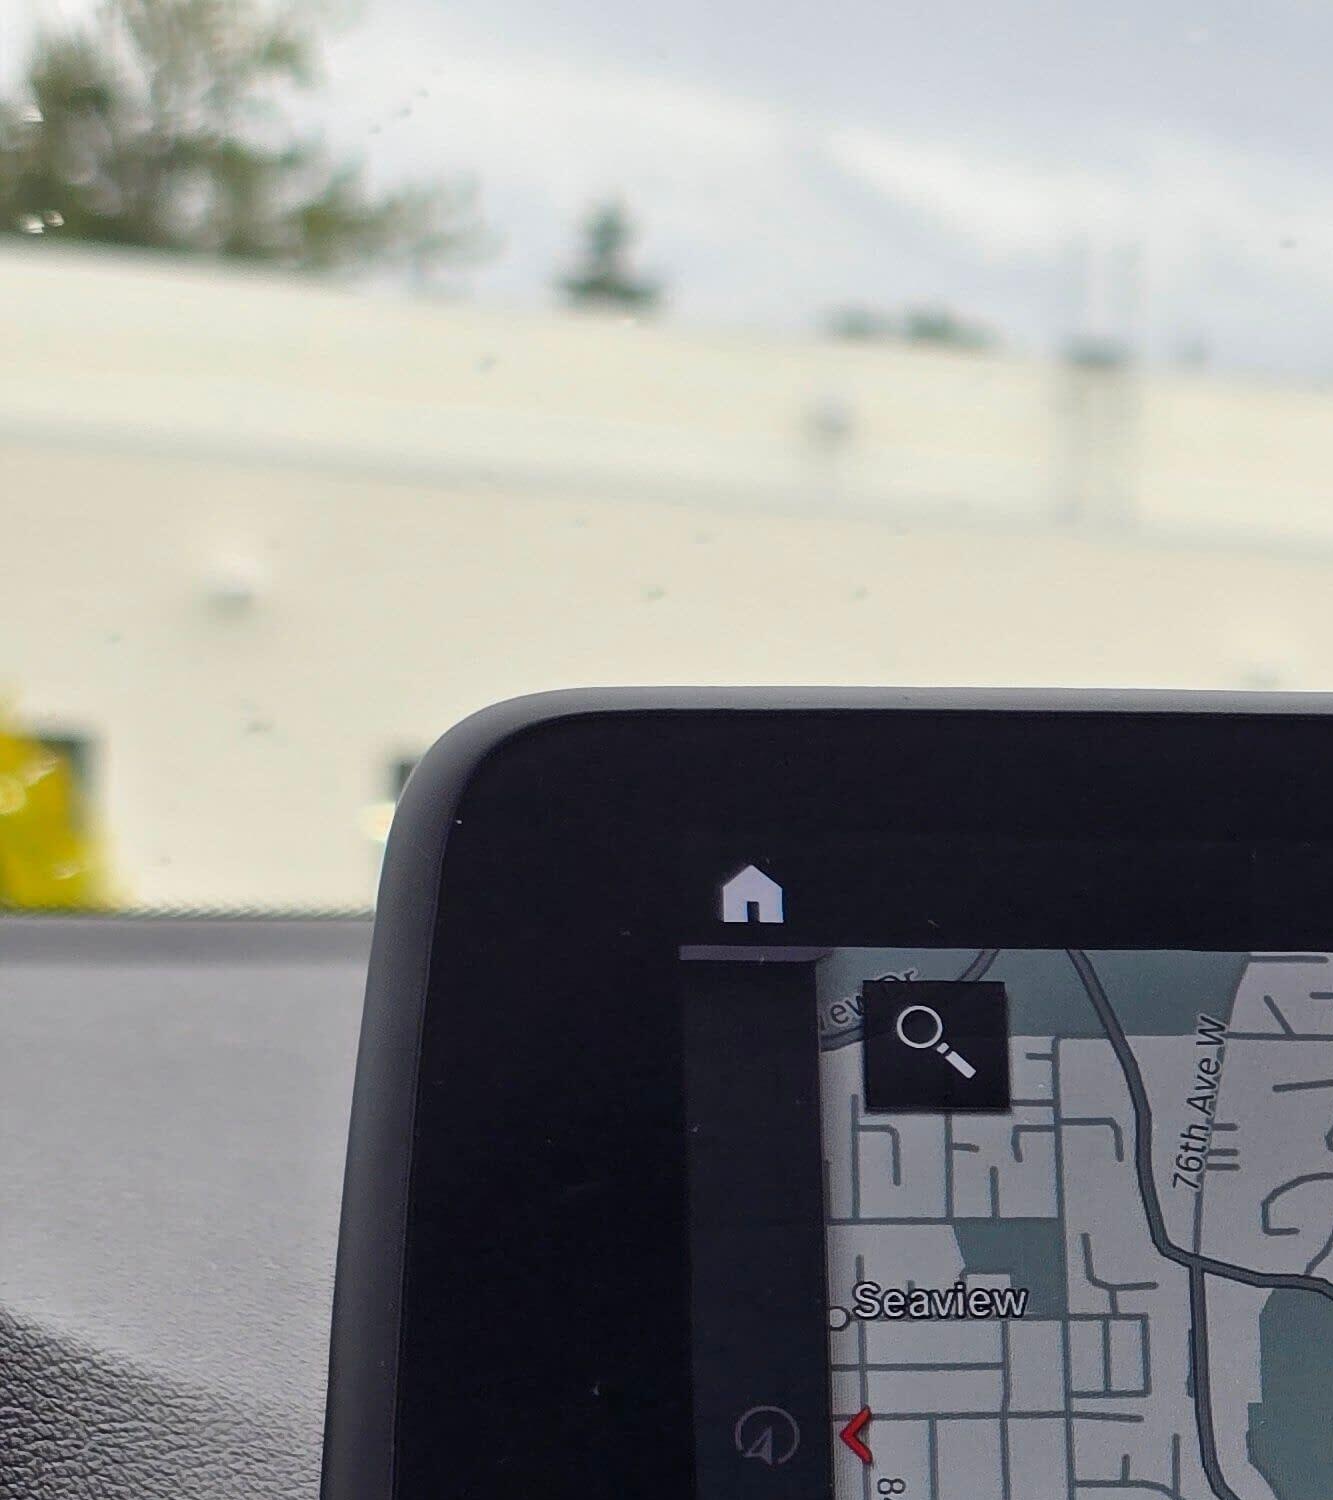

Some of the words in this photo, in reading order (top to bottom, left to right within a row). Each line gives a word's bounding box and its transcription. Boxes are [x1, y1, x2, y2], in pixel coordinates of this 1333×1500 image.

[1196, 1015, 1226, 1046] W
[1186, 1057, 1221, 1116] Ave
[1172, 1124, 1209, 1189] 76th
[853, 1281, 1029, 1319] Seaview
